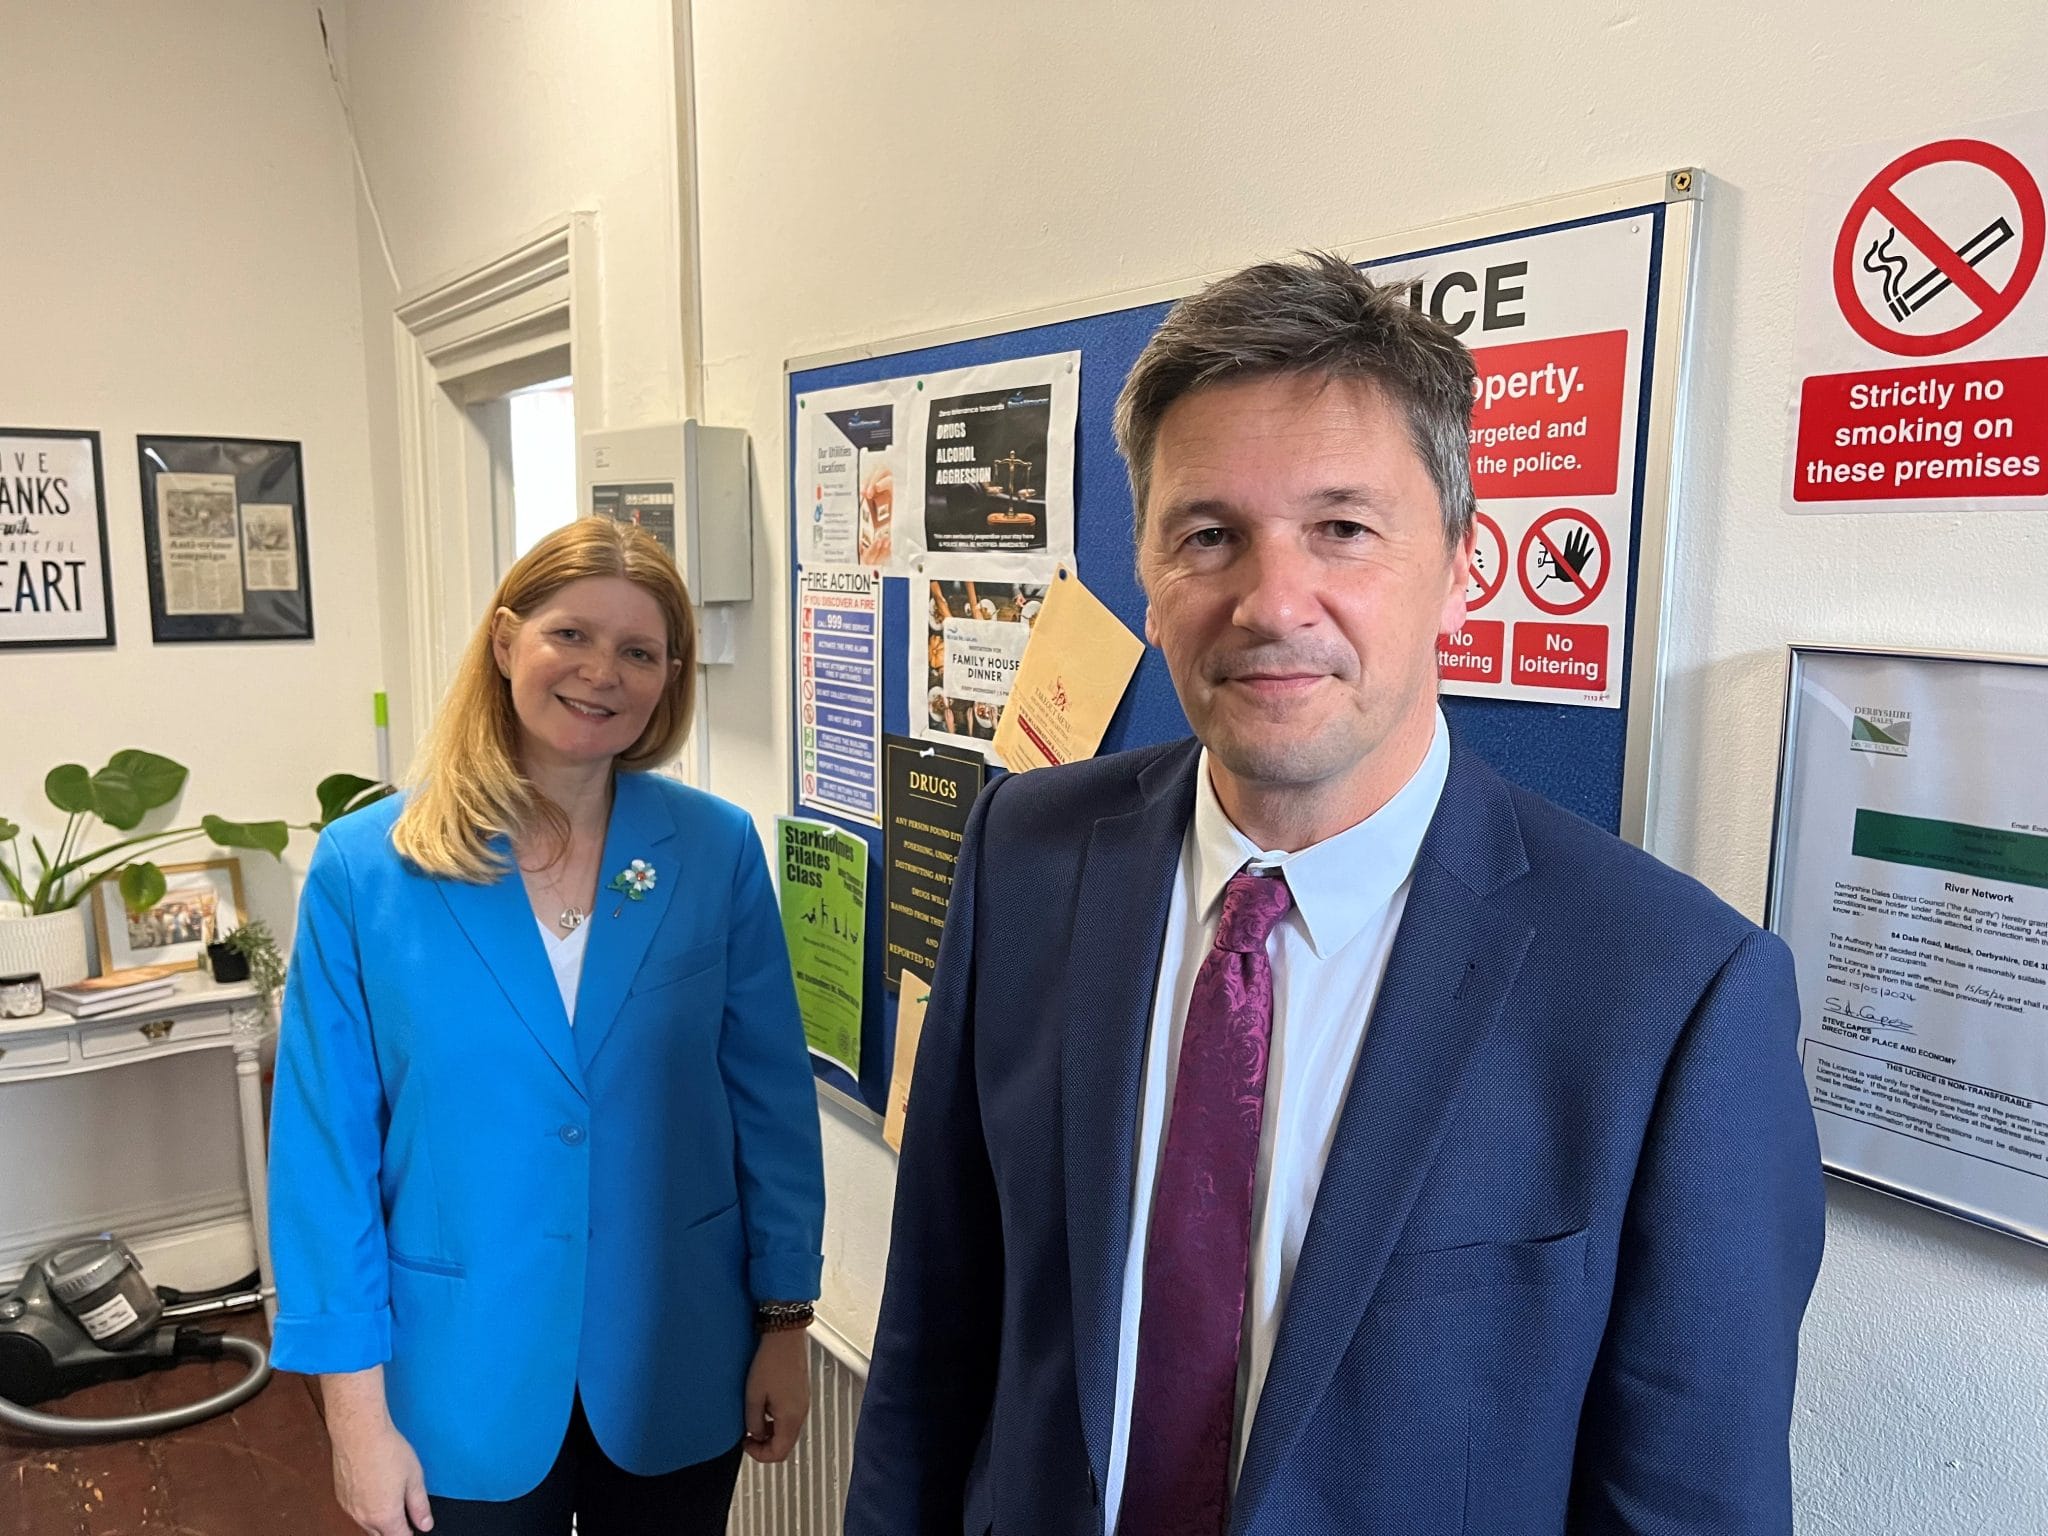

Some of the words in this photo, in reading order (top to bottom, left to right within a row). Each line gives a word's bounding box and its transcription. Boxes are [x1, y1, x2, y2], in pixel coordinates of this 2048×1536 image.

[1850, 379, 1954, 410] Strictly
[1964, 379, 2004, 401] no
[936, 422, 966, 440] DRUGS
[1547, 417, 1587, 438] and
[1835, 417, 1963, 447] smoking
[1973, 417, 2013, 440] on
[936, 446, 976, 463] ALCOHOL
[1477, 456, 1507, 474] the
[1513, 452, 1582, 477] police.
[936, 467, 991, 484] AGGRESSION
[1806, 460, 1885, 483] these
[1894, 452, 2041, 486] premises
[808, 572, 828, 588] FIRE
[831, 574, 871, 590] ACTION
[823, 597, 852, 608] DISCOVER
[860, 599, 875, 609] FIRE
[827, 614, 842, 628] 999
[1449, 630, 1473, 646] No
[1546, 633, 1573, 652] No
[953, 654, 984, 666] FAMILY
[988, 658, 1020, 671] HOUSE
[1519, 655, 1599, 681] loitering
[968, 668, 1002, 681] DINNER
[1855, 707, 1912, 719] DERBYSHIRE
[910, 771, 957, 799] DRUGS
[896, 816, 907, 826] ANY
[908, 820, 929, 832] PERSON
[930, 826, 950, 838] FOUND
[786, 845, 830, 871] Pilates
[786, 864, 823, 888] Class
[935, 874, 947, 883] ANY
[1945, 882, 1969, 894] River
[1972, 888, 2014, 903] Network
[890, 902, 913, 916] BANNED
[914, 911, 929, 922] FROM
[1833, 906, 1851, 914] know
[1834, 891, 1857, 899] named
[1885, 900, 1908, 908] holder
[1911, 904, 1931, 913] under
[1935, 909, 1960, 919] Section
[1986, 919, 1998, 927] the
[2001, 922, 2032, 935] Housing
[2035, 929, 2048, 937] Act
[1835, 881, 1870, 893] Derbyshire
[1872, 888, 1890, 898] Dales
[1892, 893, 1917, 901] District
[1919, 897, 1945, 907] Council
[2001, 913, 2026, 925] hereby
[2029, 919, 2048, 928] grant
[1833, 899, 1866, 910] conditions
[1867, 904, 1877, 912] set
[1878, 907, 1889, 915] out
[1911, 913, 1942, 924] schedule
[1984, 929, 2024, 942] connection
[2025, 937, 2040, 945] with
[926, 938, 939, 948] AND
[1902, 934, 1919, 943] Dale
[1921, 937, 1942, 948] Road,
[1944, 942, 1973, 956] Matlock,
[1976, 949, 2020, 965] Derbyshire,
[2022, 959, 2039, 968] DE4
[889, 944, 924, 964] REPORTED
[925, 957, 935, 969] TO
[1830, 932, 1843, 941] The
[1844, 936, 1873, 949] Authority
[1874, 942, 1887, 951] has
[1889, 947, 1917, 956] decided
[1918, 951, 1932, 960] that
[1933, 955, 1944, 963] the
[1946, 958, 1966, 967] house
[1976, 965, 2016, 979] reasonably
[2017, 974, 2046, 985] suitable
[1829, 954, 1843, 963] This
[1844, 958, 1869, 969] Licence
[1878, 968, 1905, 977] granted
[1907, 972, 1921, 980] with
[1944, 980, 1959, 989] from
[1827, 963, 1848, 972] period
[1862, 971, 1880, 980] years
[1882, 975, 1899, 984] from
[1900, 978, 1913, 987] this
[1933, 987, 1954, 997] unless
[1955, 993, 1993, 1007] previously
[2007, 996, 2021, 1004] and
[2023, 999, 2040, 1008] shall
[1822, 1016, 1845, 1029] STEVE
[1846, 1023, 1872, 1034] CAPES
[1821, 1024, 1858, 1039] DIRECTOR
[1871, 1037, 1899, 1049] PLACE
[1900, 1044, 1917, 1054] AND
[1918, 1049, 1957, 1065] ECONOMY
[1886, 1063, 1903, 1073] THIS
[1904, 1068, 1936, 1082] LICENCE
[1947, 1080, 2032, 1109] NON-TRANSFERABLE
